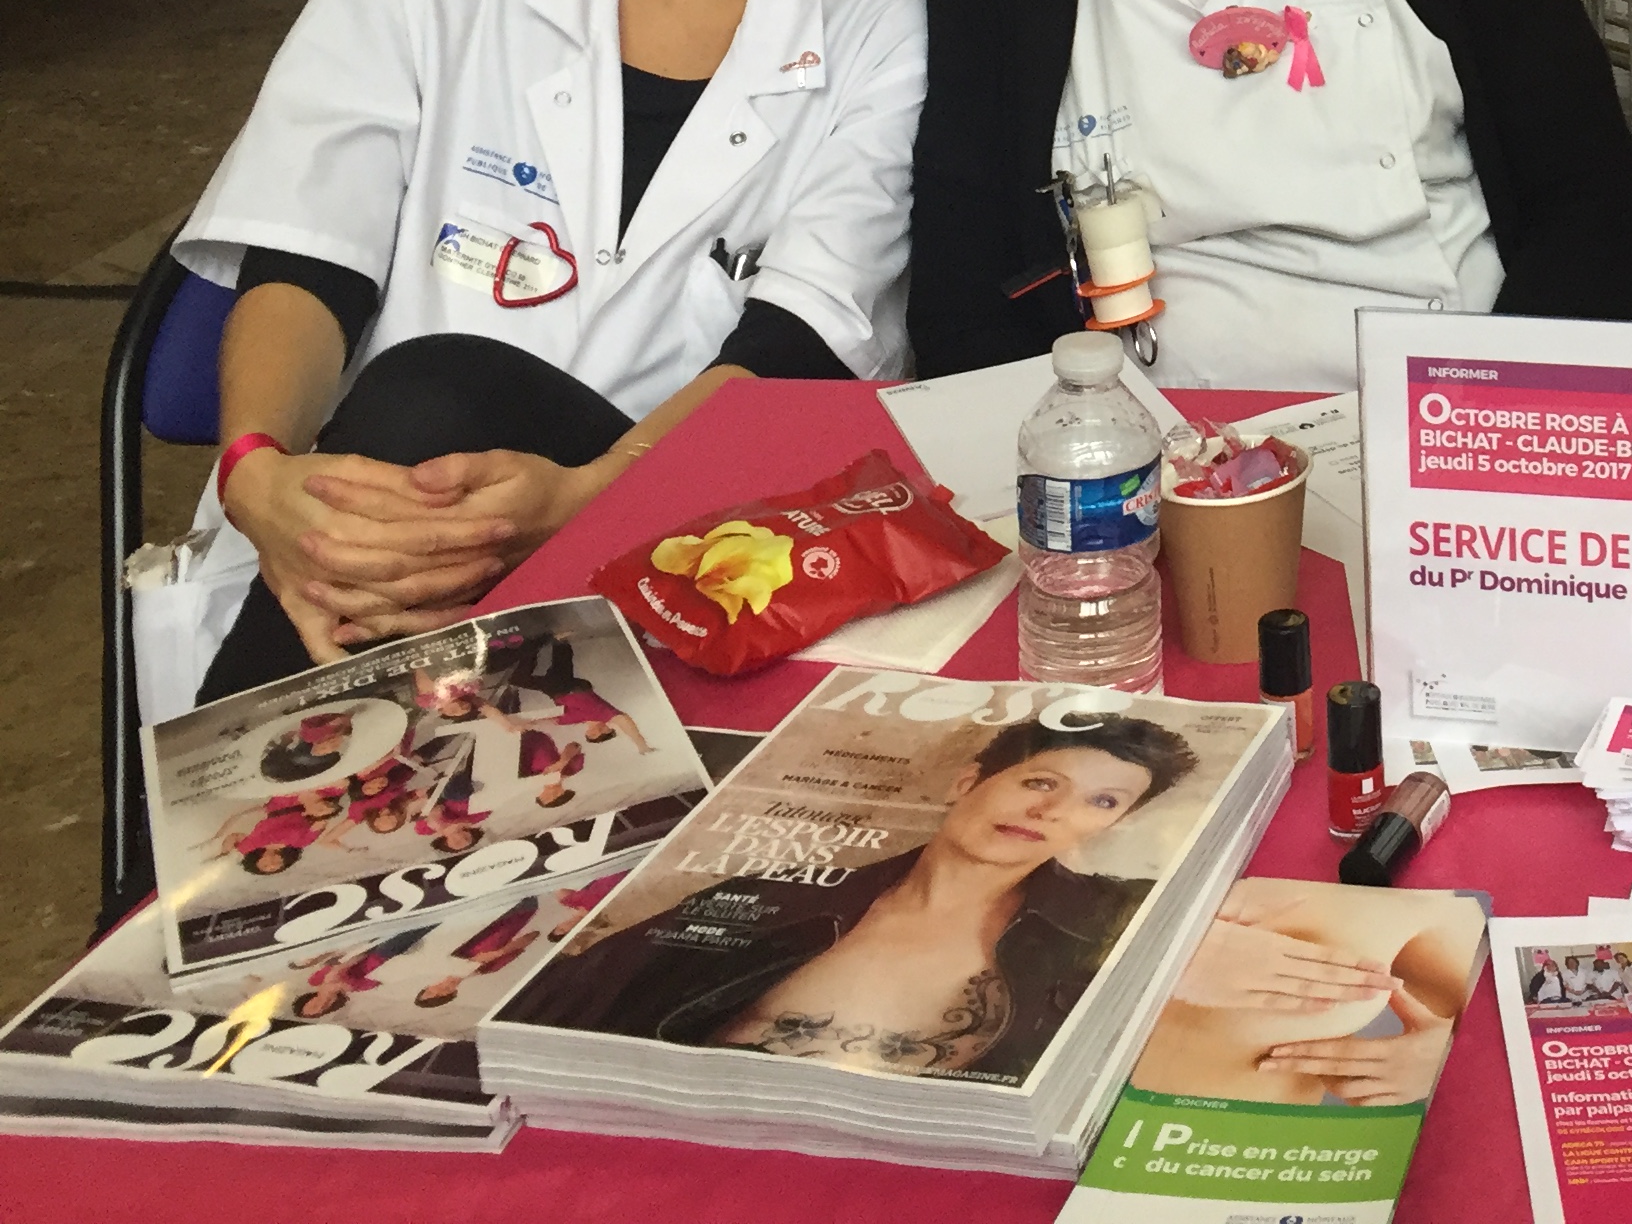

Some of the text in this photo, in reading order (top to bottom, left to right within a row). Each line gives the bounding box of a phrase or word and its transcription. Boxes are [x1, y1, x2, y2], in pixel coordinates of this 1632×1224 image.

[1427, 366, 1498, 380] INFORMER
[1419, 392, 1540, 429] OCTOBRE
[1545, 413, 1607, 433] ROSE
[1611, 412, 1629, 434] À
[1419, 431, 1501, 451] BICHAT
[1418, 450, 1473, 472] jeudi
[1477, 454, 1490, 471] 5
[1493, 457, 1578, 476] octobre
[1582, 460, 1631, 479] 2017
[1409, 521, 1566, 564] SERVICE
[1580, 531, 1630, 569] DE
[1409, 564, 1443, 587] du
[1479, 569, 1627, 602] Dominique
[708, 813, 889, 849] L'ESPOIR
[723, 834, 841, 864] DANS
[674, 850, 857, 888] LA PEAU
[712, 891, 760, 903] SANTÉ
[685, 924, 727, 936] MODE
[1152, 1122, 1379, 1165] Prise en charge
[1145, 1156, 1372, 1182] du cancer du sein
